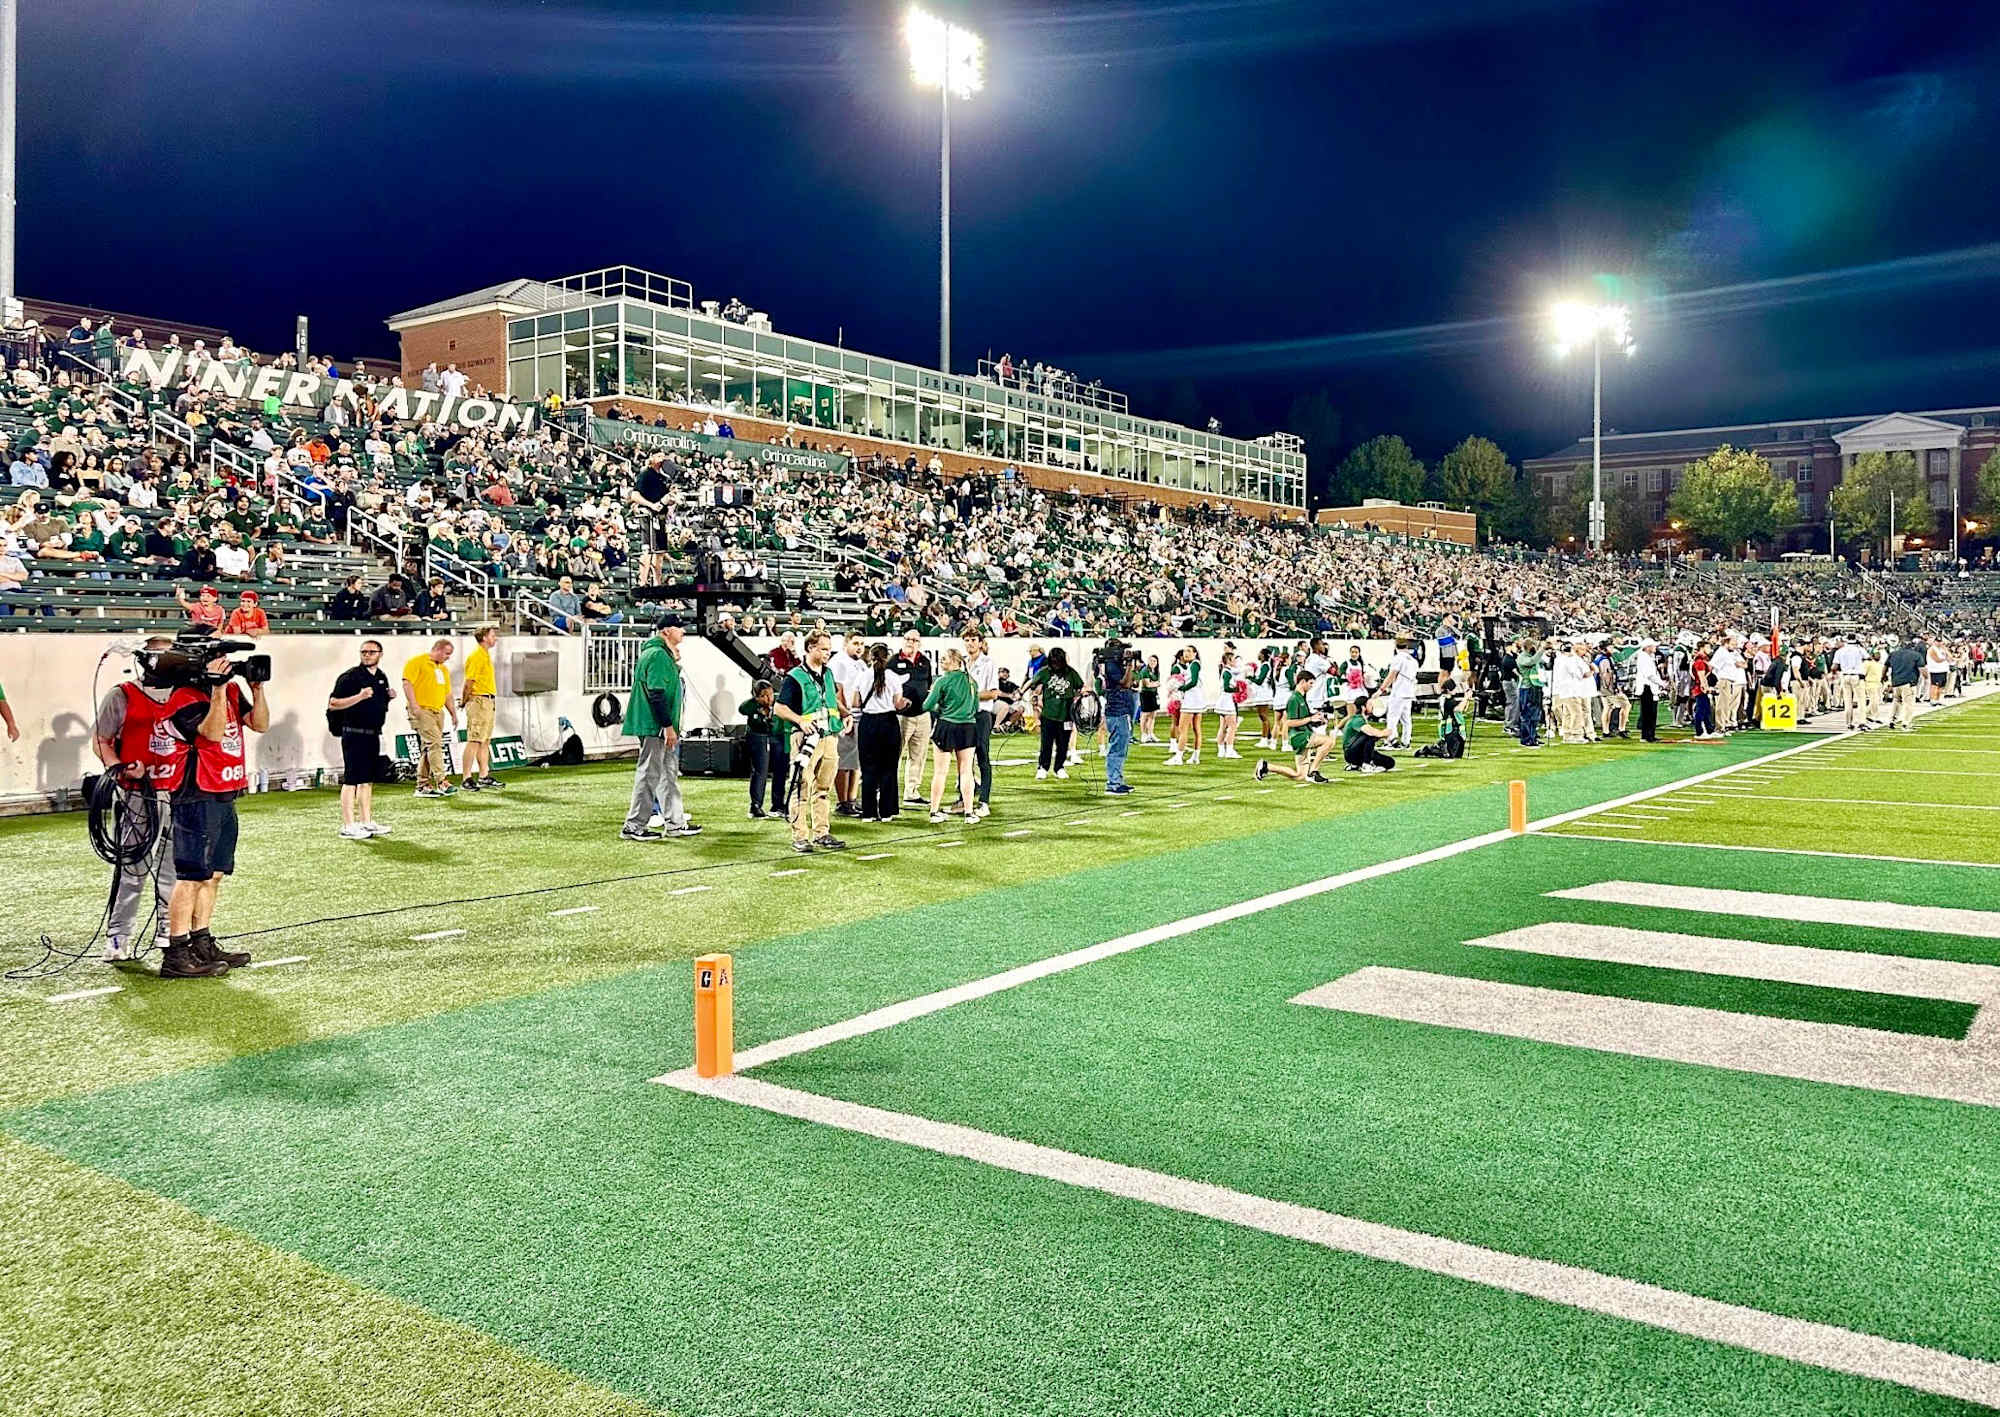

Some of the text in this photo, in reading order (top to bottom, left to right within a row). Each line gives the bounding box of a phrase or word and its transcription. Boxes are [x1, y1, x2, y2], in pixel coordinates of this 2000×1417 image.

[122, 348, 535, 433] NINER NATION
[924, 377, 972, 396] JERRY
[1007, 395, 1100, 423] RICHARDSON
[623, 427, 701, 451] OrthoCarolina
[761, 448, 827, 469] OrthoCarolina
[1774, 561, 1838, 572] STANDARD
[1767, 703, 1791, 719] 12
[488, 741, 526, 763] LET'S
